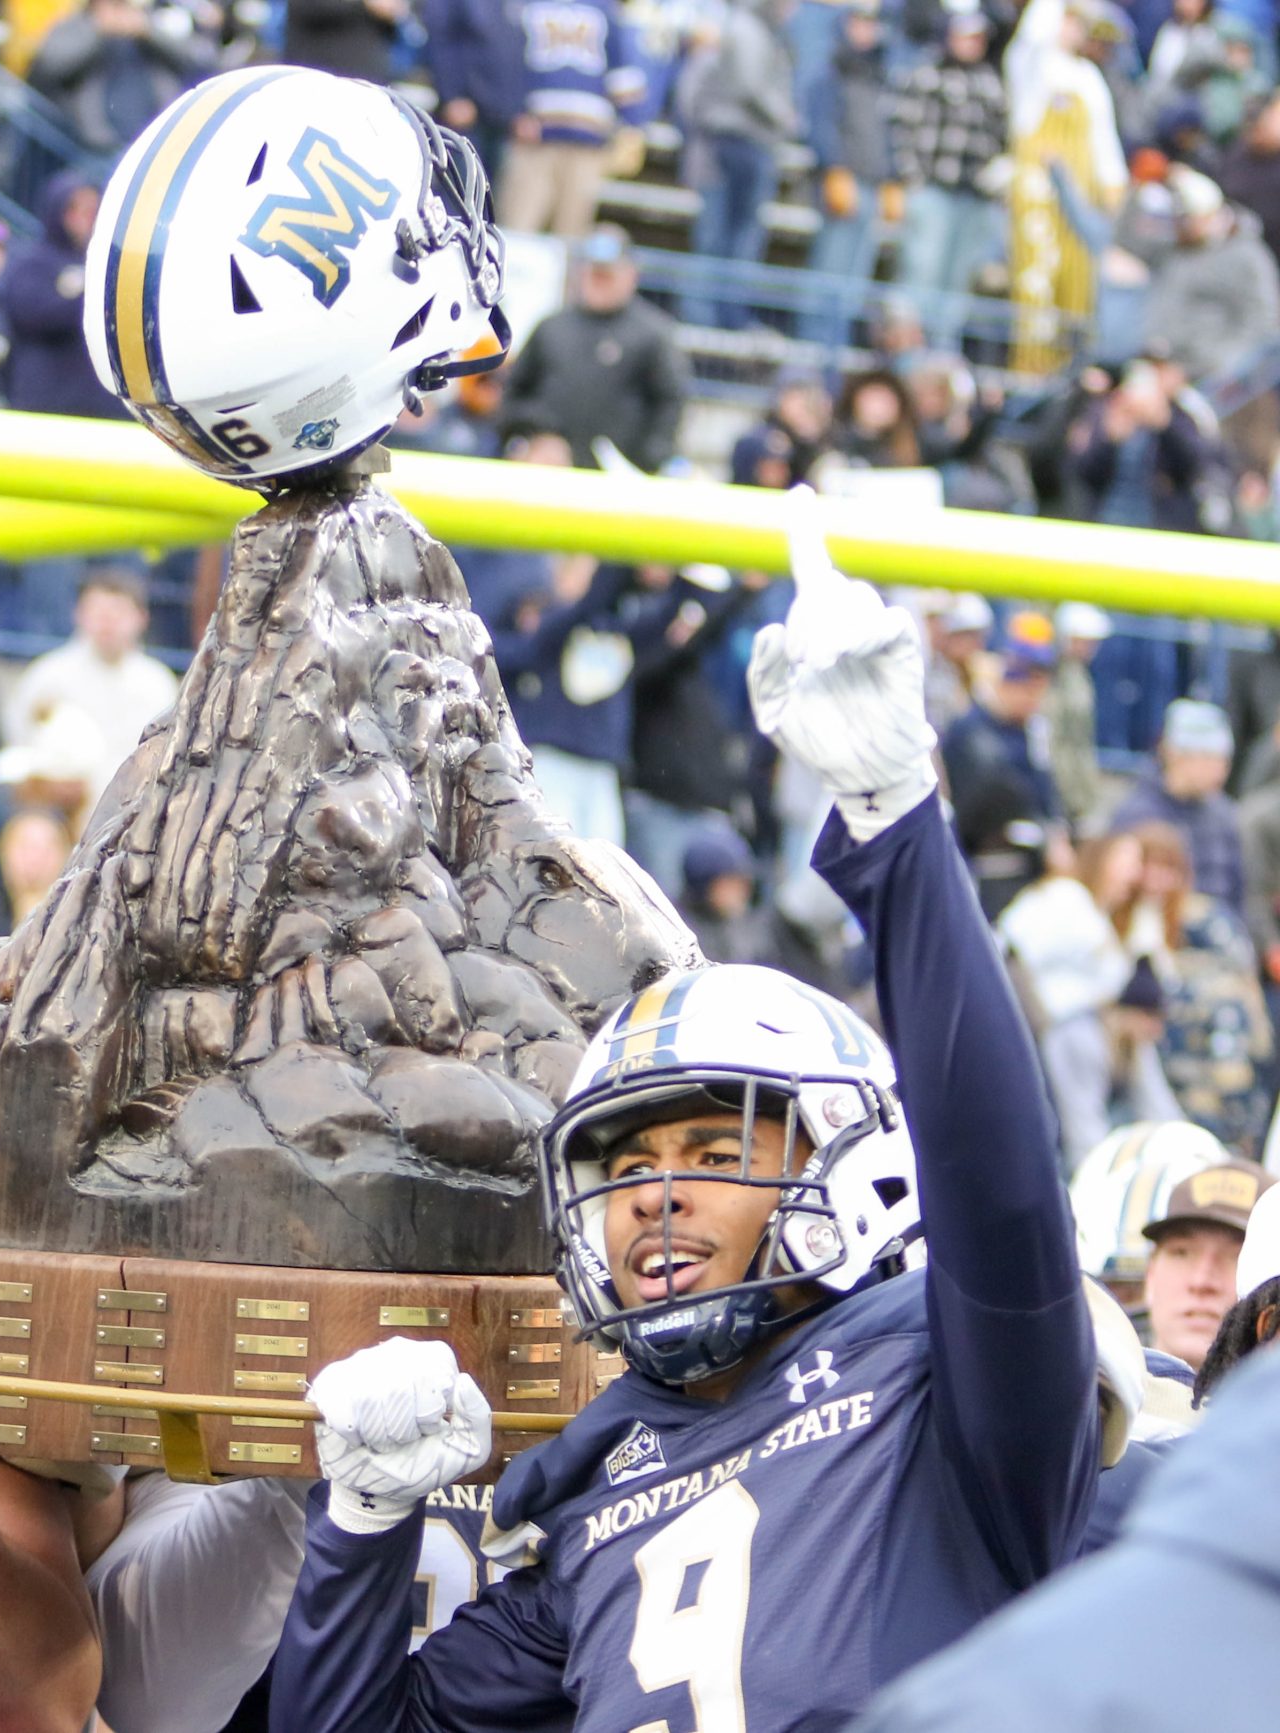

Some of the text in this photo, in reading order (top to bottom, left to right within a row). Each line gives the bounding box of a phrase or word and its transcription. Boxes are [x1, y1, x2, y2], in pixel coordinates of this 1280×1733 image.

[237, 126, 402, 310] M
[210, 417, 272, 460] 6
[639, 1311, 696, 1338] Riddell
[584, 1391, 874, 1551] MONTANA STATE
[629, 1478, 761, 1733] 9
